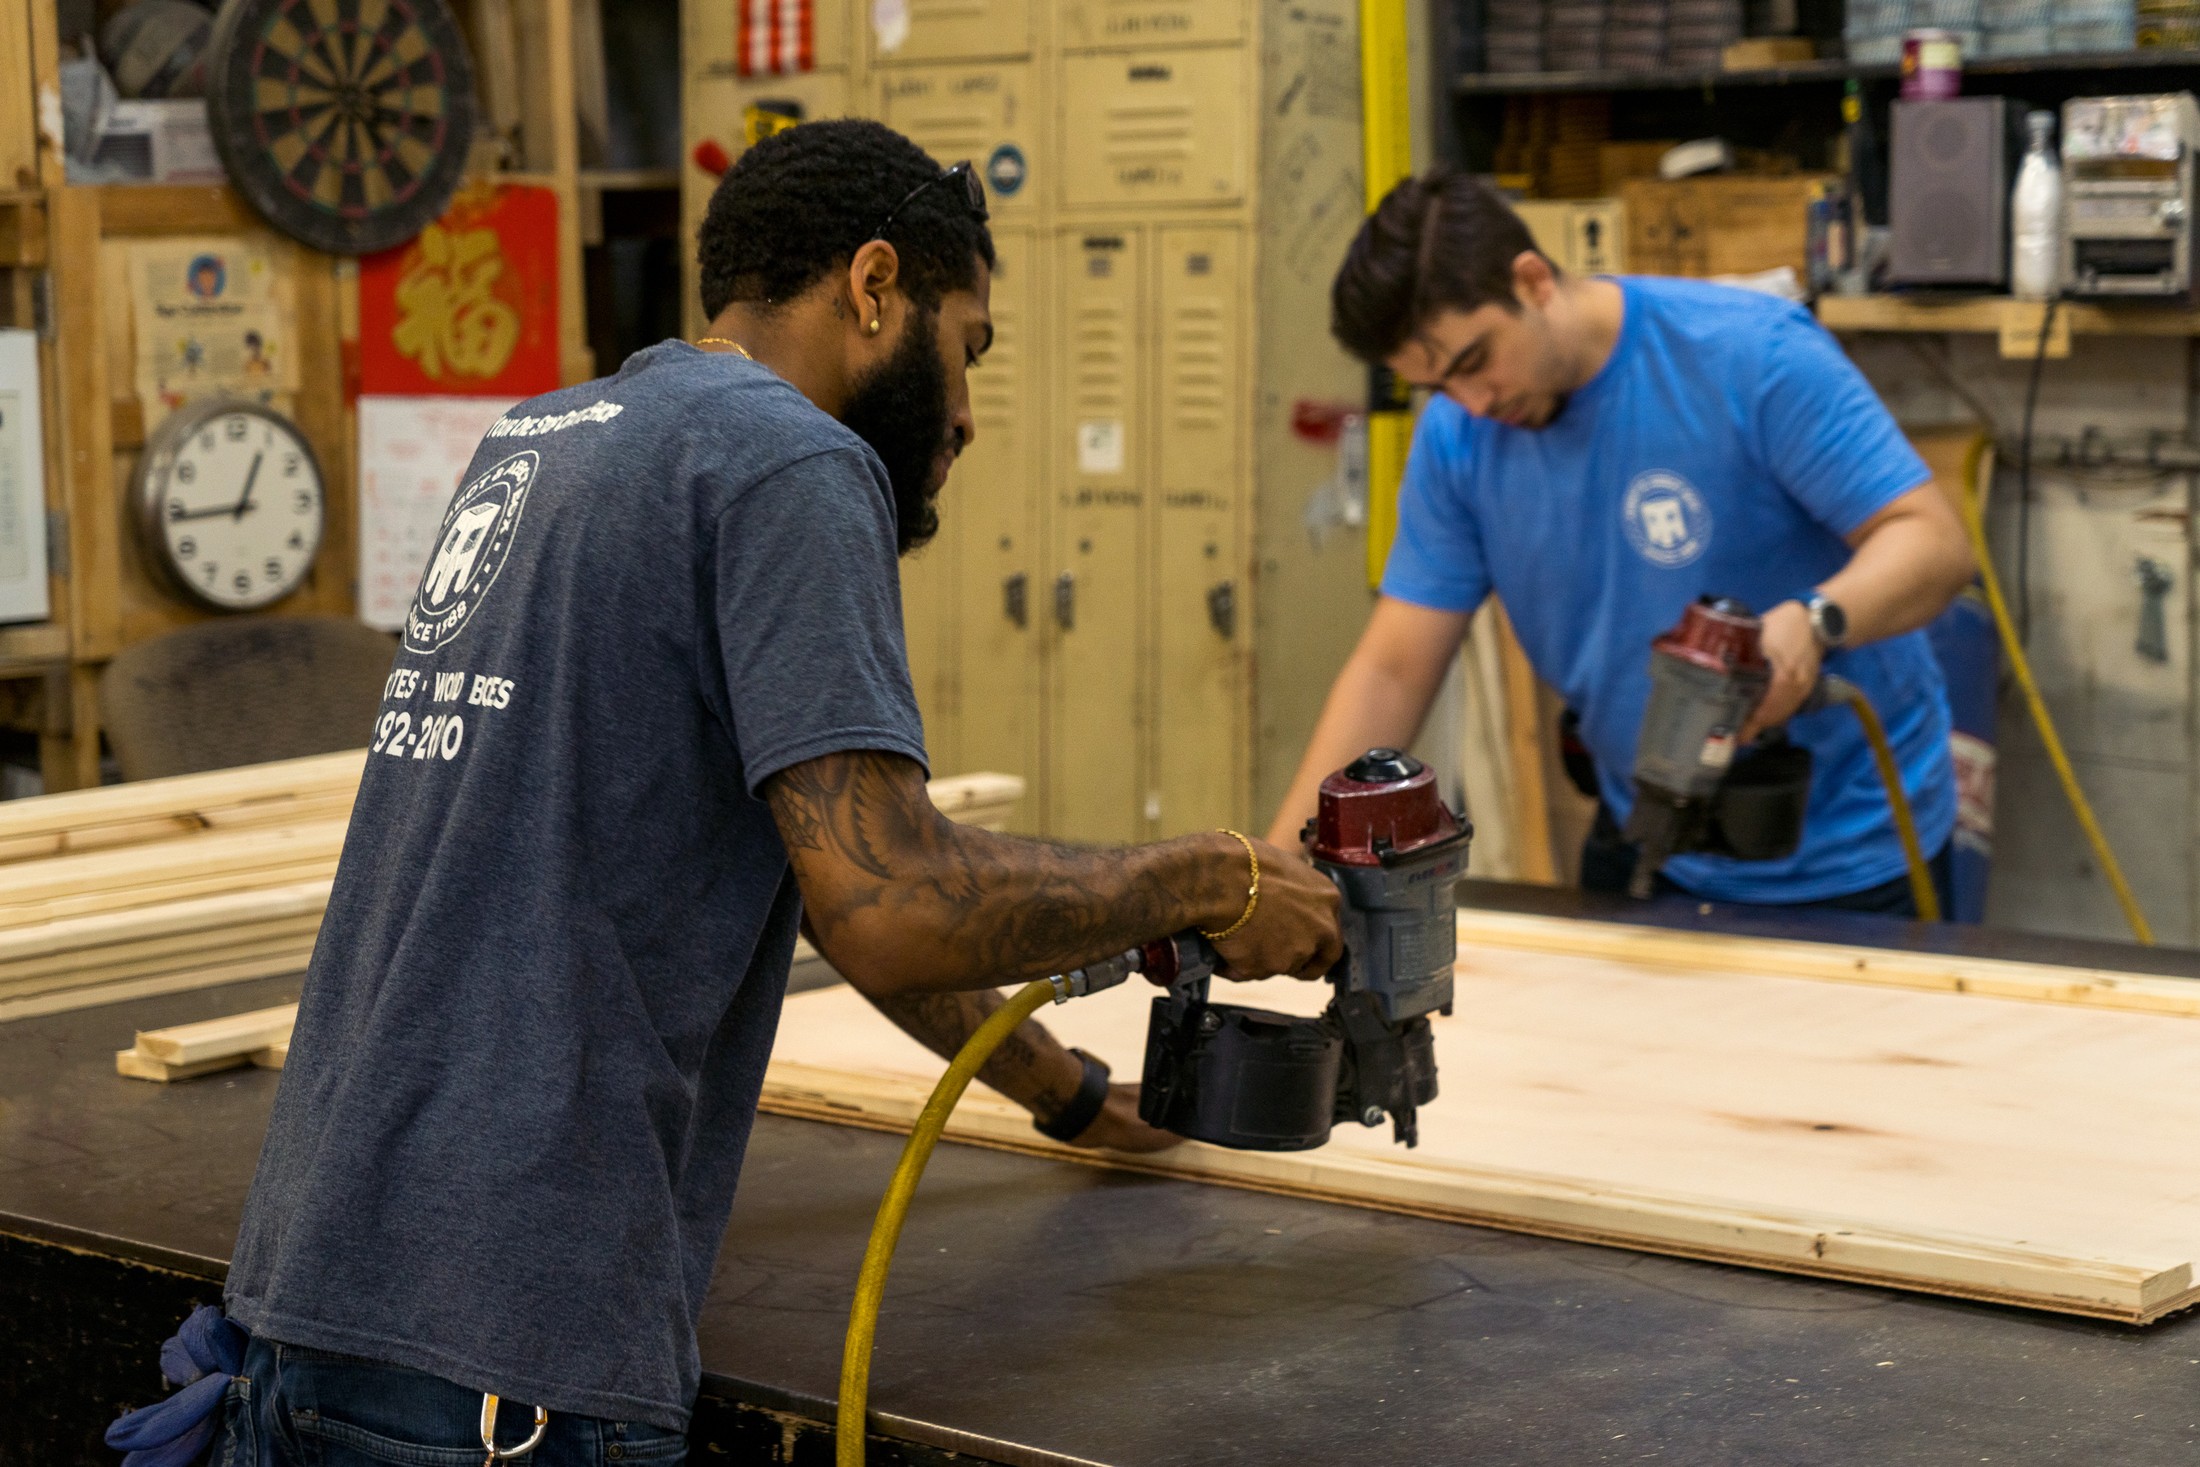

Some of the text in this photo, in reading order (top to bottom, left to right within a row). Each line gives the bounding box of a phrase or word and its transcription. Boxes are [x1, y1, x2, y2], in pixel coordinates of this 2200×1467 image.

[393, 221, 520, 379] 福
[383, 668, 516, 710] TES WOD BOES
[373, 710, 464, 761] 92-20
